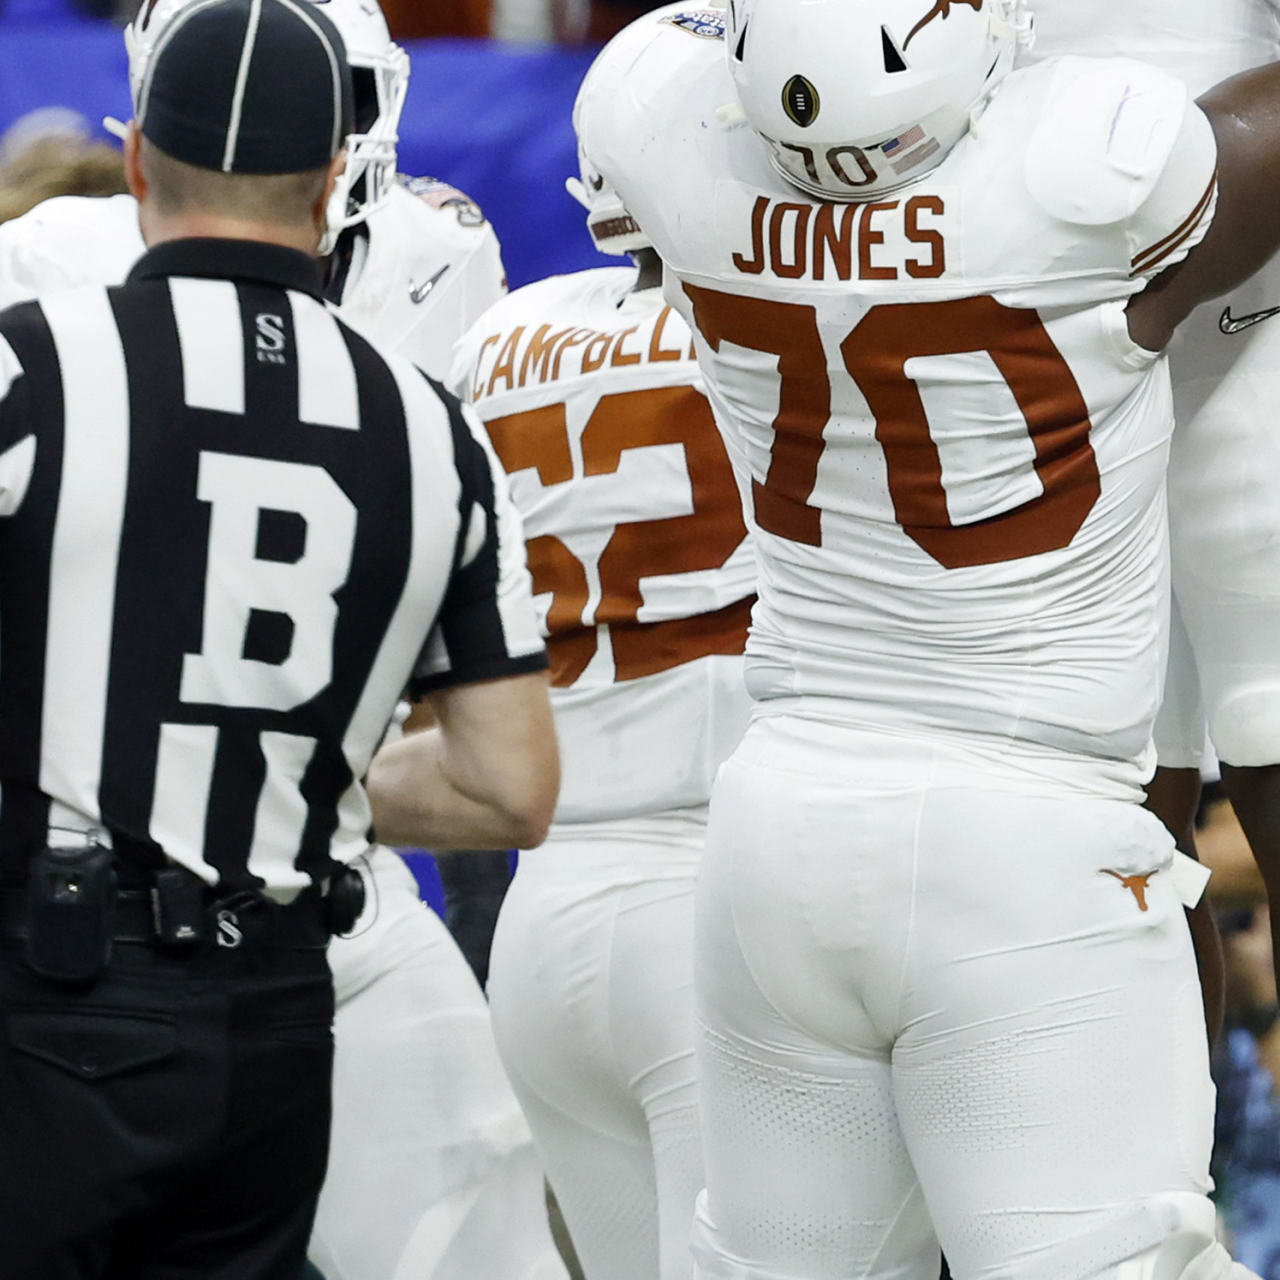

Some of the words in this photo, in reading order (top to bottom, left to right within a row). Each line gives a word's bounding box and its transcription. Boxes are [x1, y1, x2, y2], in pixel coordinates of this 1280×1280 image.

[732, 194, 946, 280] JONES
[780, 140, 878, 187] 70
[472, 306, 698, 403] CAMPBEL
[682, 281, 1102, 570] 70
[179, 450, 358, 712] B
[484, 385, 757, 687] 52
